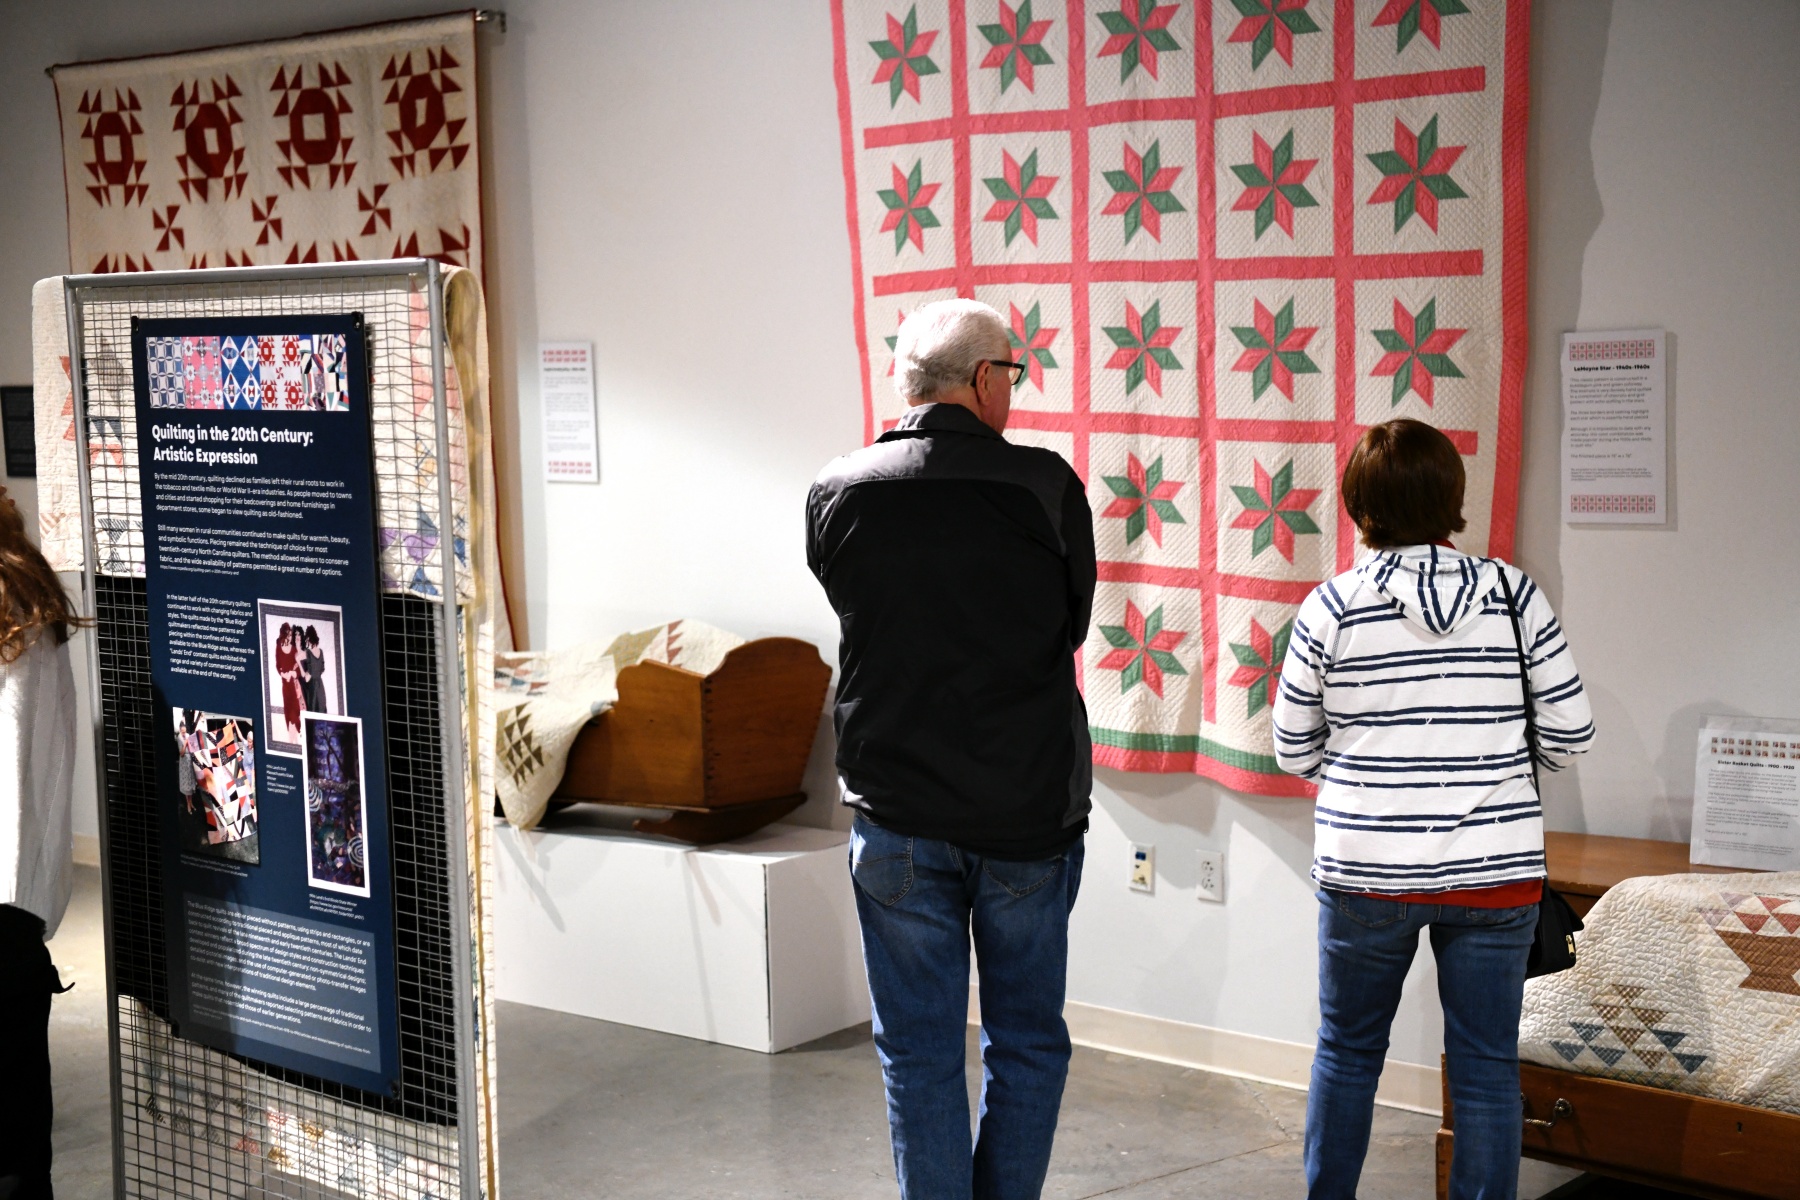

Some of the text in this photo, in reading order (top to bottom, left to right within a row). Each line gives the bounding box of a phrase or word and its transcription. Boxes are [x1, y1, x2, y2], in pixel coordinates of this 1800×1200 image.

[151, 424, 314, 447] Quilting in the 20th Century:
[153, 445, 258, 468] Artistic Expression
[154, 473, 160, 481] By
[208, 475, 225, 483] quilting
[294, 490, 311, 498] people
[203, 496, 224, 505] shopping
[244, 498, 276, 507] bedcoverings
[302, 501, 329, 510] furnishings
[156, 504, 182, 513] department
[212, 507, 226, 516] began
[244, 509, 261, 518] quilting
[212, 528, 241, 536] communities
[242, 530, 266, 538] continued
[287, 533, 300, 541] quilts
[167, 535, 187, 544] symbolic
[210, 538, 226, 547] Piecing
[227, 539, 249, 547] remained
[258, 541, 282, 551] technique
[289, 543, 306, 551] choice
[315, 545, 328, 553] most
[159, 545, 198, 555] twentieth-century
[212, 549, 231, 557] Carolina
[280, 554, 299, 562] allowed
[300, 555, 318, 563] makers
[203, 559, 226, 568] availability
[232, 561, 252, 570] patterns
[253, 562, 277, 572] permitted
[282, 565, 295, 573] great
[296, 566, 315, 574] number
[219, 599, 235, 607] century
[235, 600, 251, 608] quilters
[211, 608, 229, 616] changing
